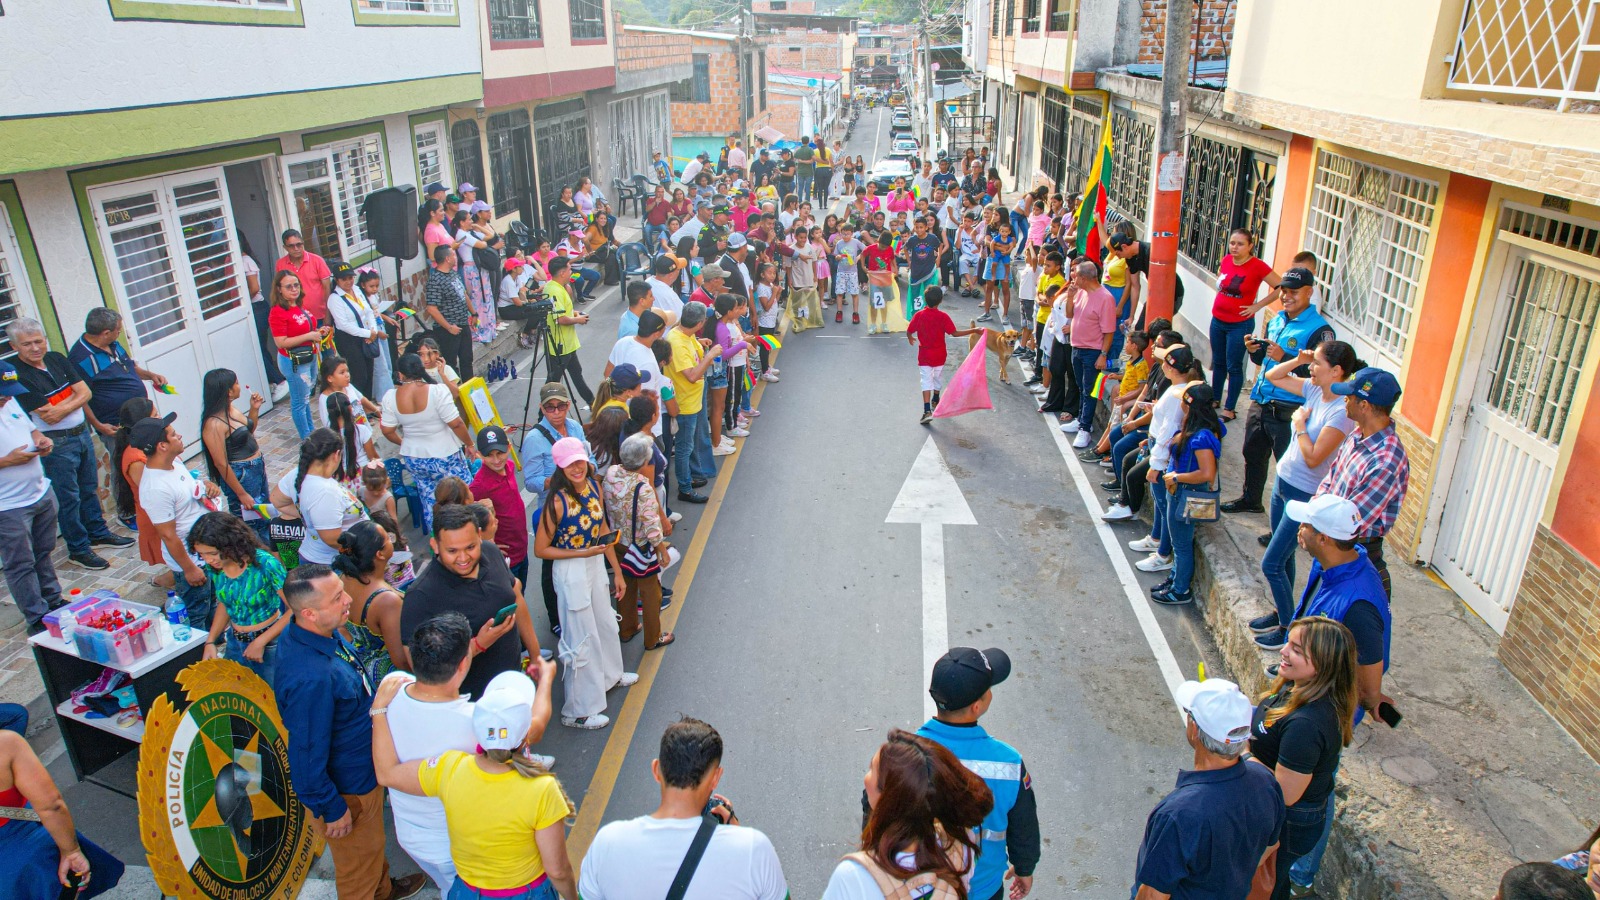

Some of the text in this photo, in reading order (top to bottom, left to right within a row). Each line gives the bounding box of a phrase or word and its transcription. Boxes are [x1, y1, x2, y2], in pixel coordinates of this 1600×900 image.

[876, 295, 883, 306] 2
[200, 696, 261, 725] NACIONAL
[168, 750, 184, 829] POLICÍA
[192, 861, 221, 897] UNIDAD
[220, 885, 233, 900] DE
[270, 799, 298, 883] MANTENIMIENTO
[283, 882, 294, 900] DE
